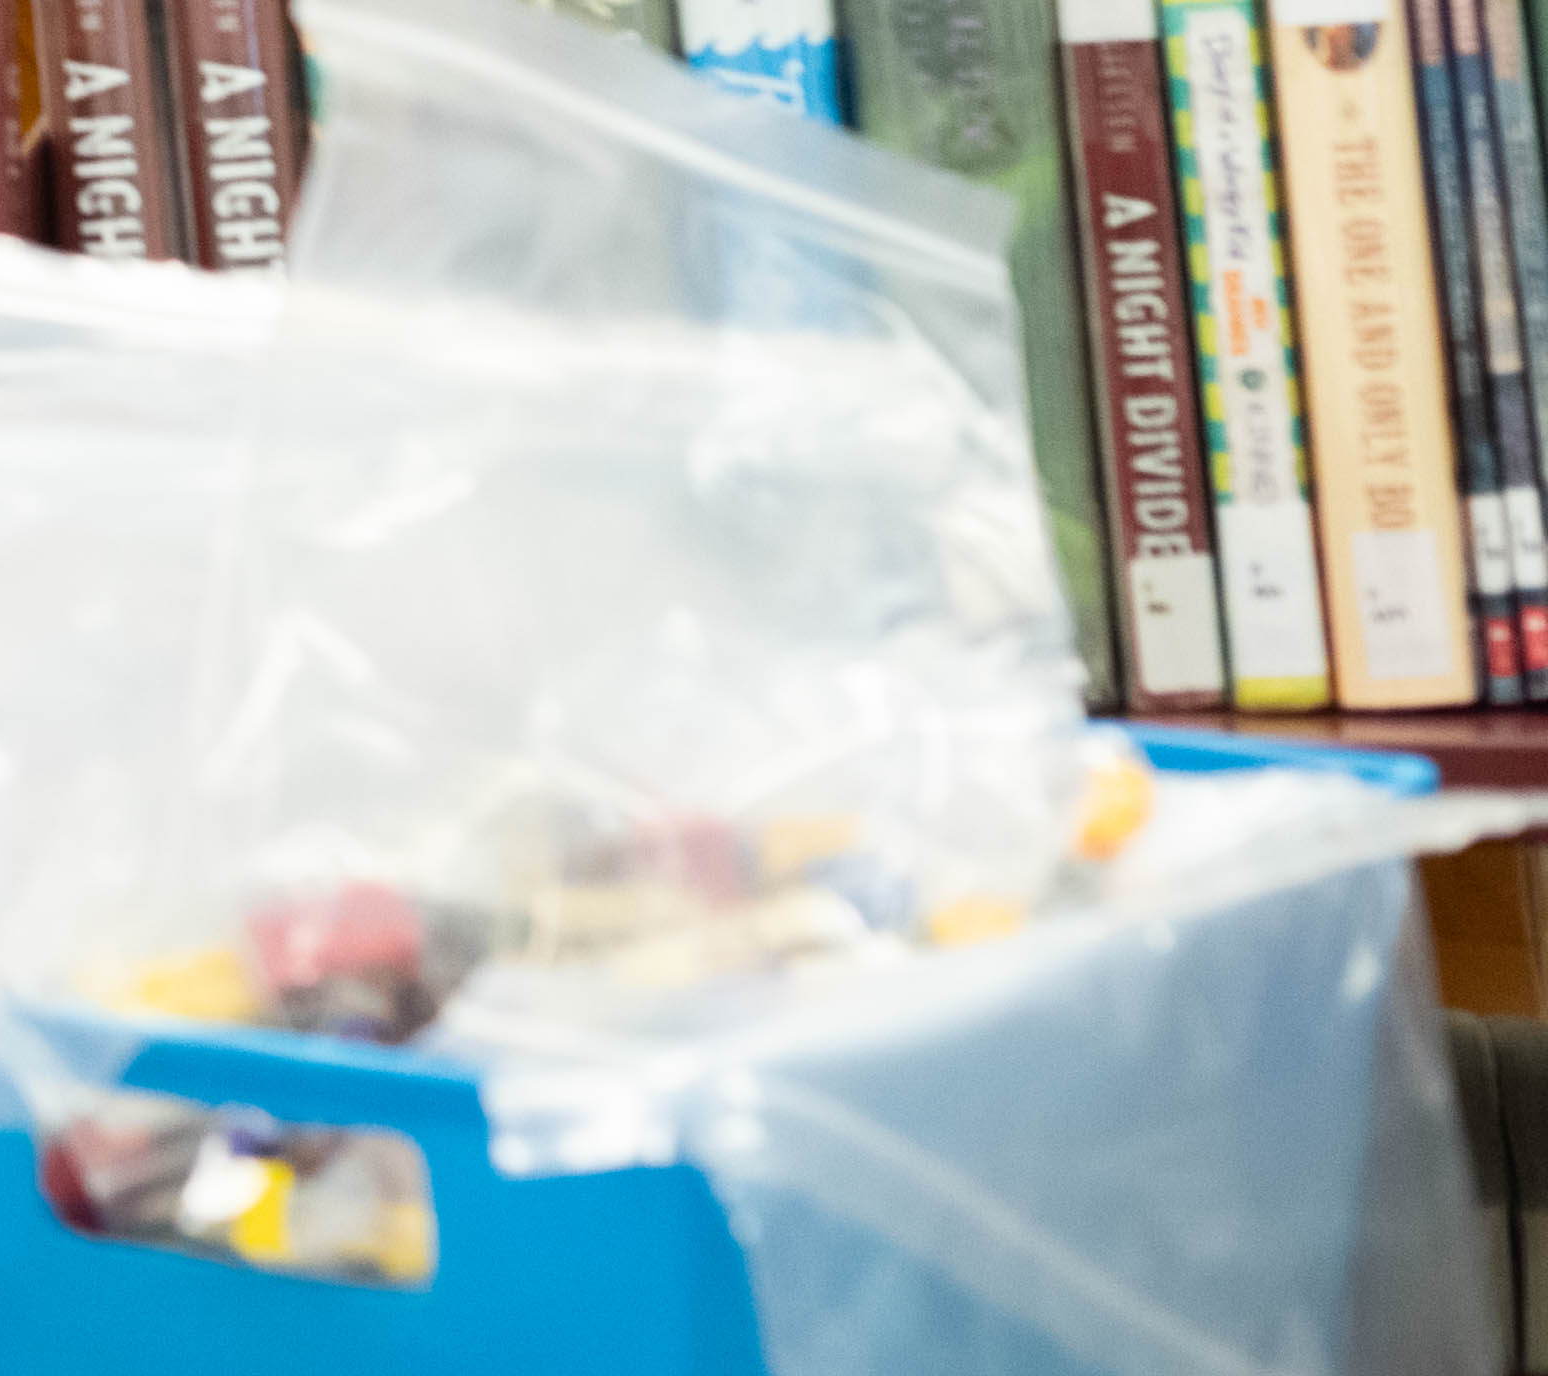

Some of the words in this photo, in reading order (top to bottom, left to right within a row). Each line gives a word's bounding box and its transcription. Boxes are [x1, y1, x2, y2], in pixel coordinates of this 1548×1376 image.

[63, 60, 131, 103] A
[199, 60, 267, 103] A
[1333, 137, 1382, 205] THE
[1102, 190, 1157, 229] A
[1340, 217, 1392, 286] ONE
[1107, 238, 1176, 381] NIGHT
[1352, 301, 1400, 372] AND
[1358, 381, 1410, 466] ONLY
